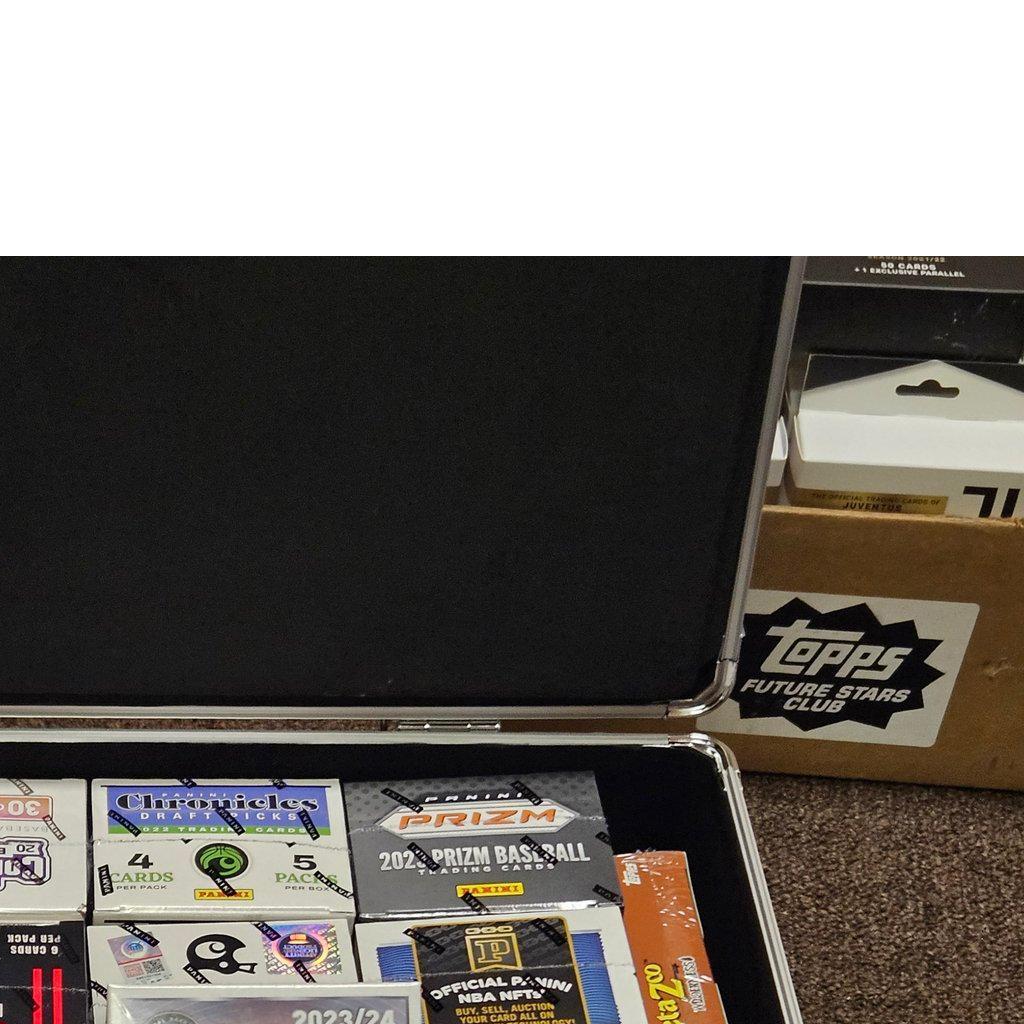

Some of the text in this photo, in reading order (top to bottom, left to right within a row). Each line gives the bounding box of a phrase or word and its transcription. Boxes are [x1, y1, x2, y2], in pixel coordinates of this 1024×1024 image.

[842, 503, 903, 512] JUVENTUS
[741, 678, 911, 703] FUTURE STARS
[783, 697, 846, 713] CLUB
[7, 800, 41, 815] 30
[116, 794, 318, 811] Chronicles
[398, 808, 556, 830] PRIZM
[16, 844, 34, 852] 20
[128, 853, 153, 869] 4
[292, 855, 317, 870] 5
[431, 847, 490, 866] PRIZM
[502, 863, 554, 871] CARDS
[110, 871, 174, 883] CARDS
[8, 934, 61, 942] PER PACK
[10, 946, 46, 954] CARDS
[430, 977, 509, 1000] OFFICIAL
[458, 992, 496, 1004] NBA
[511, 1003, 555, 1012] AUCTION
[460, 1013, 486, 1024] YOUR
[490, 1012, 517, 1022] CARD
[520, 1012, 537, 1020] ALL
